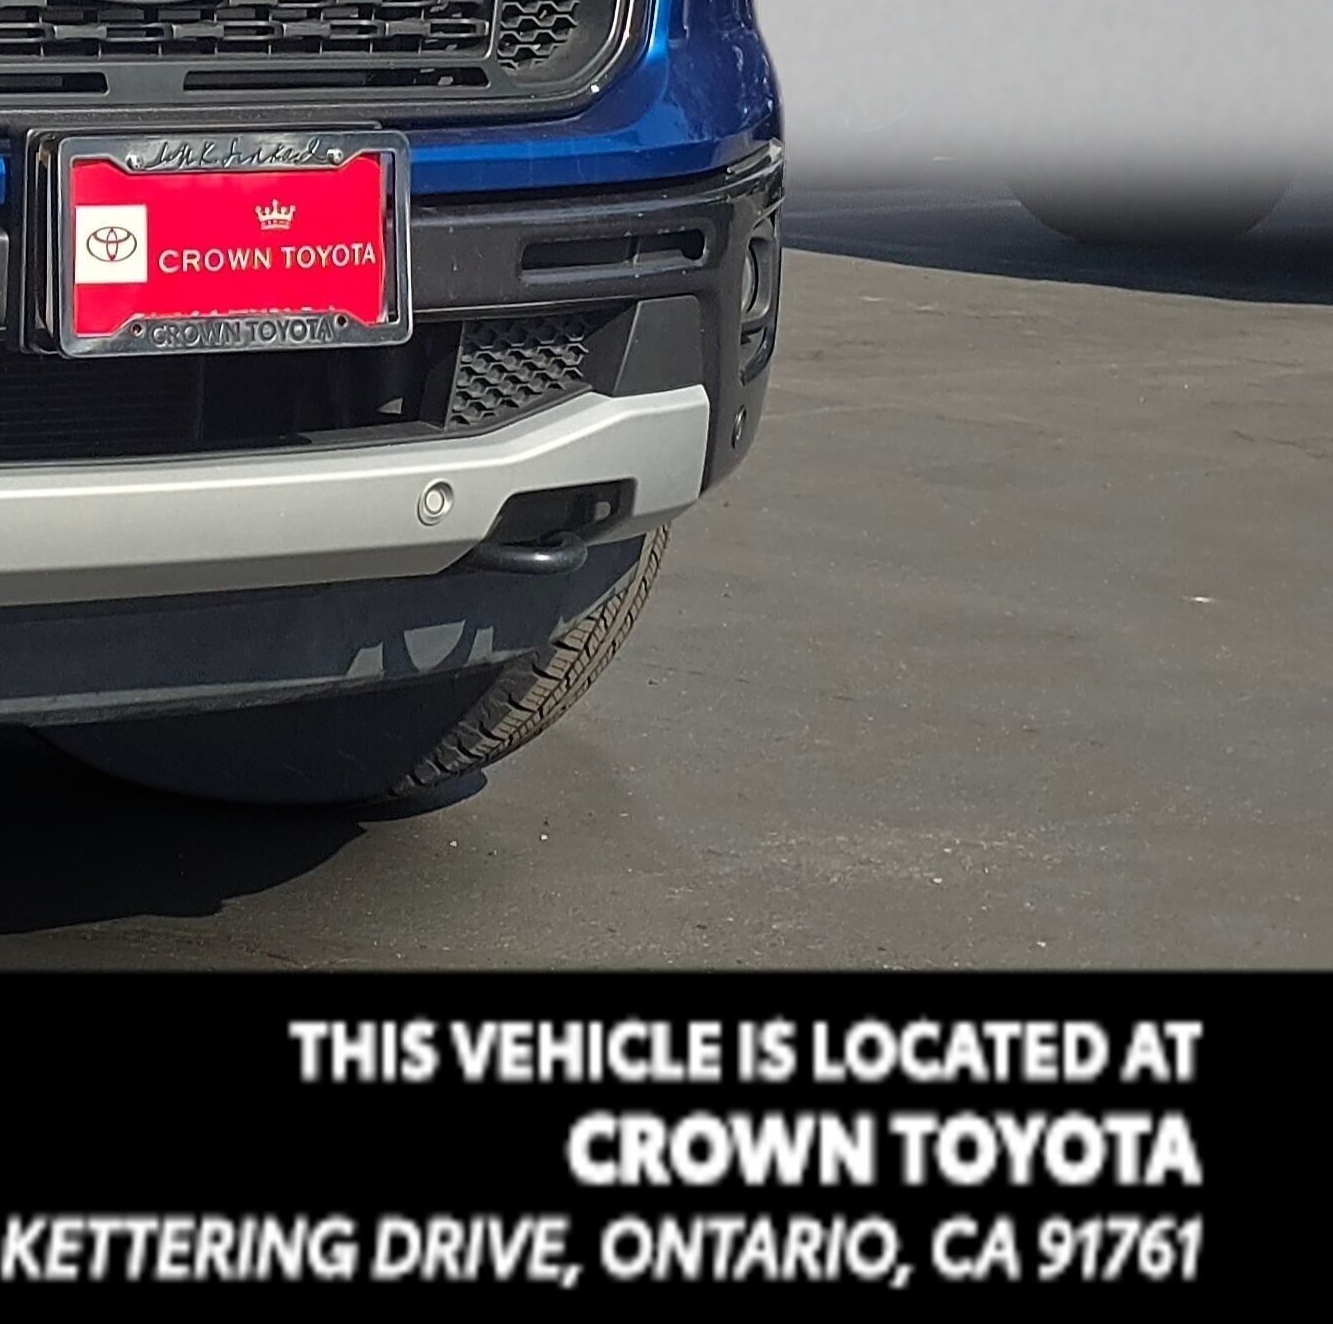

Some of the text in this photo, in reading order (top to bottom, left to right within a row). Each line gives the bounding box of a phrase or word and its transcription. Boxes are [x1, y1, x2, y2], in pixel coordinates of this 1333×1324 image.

[158, 242, 377, 274] CROWN TOYOTA
[150, 318, 333, 348] CROWN TOYOTA
